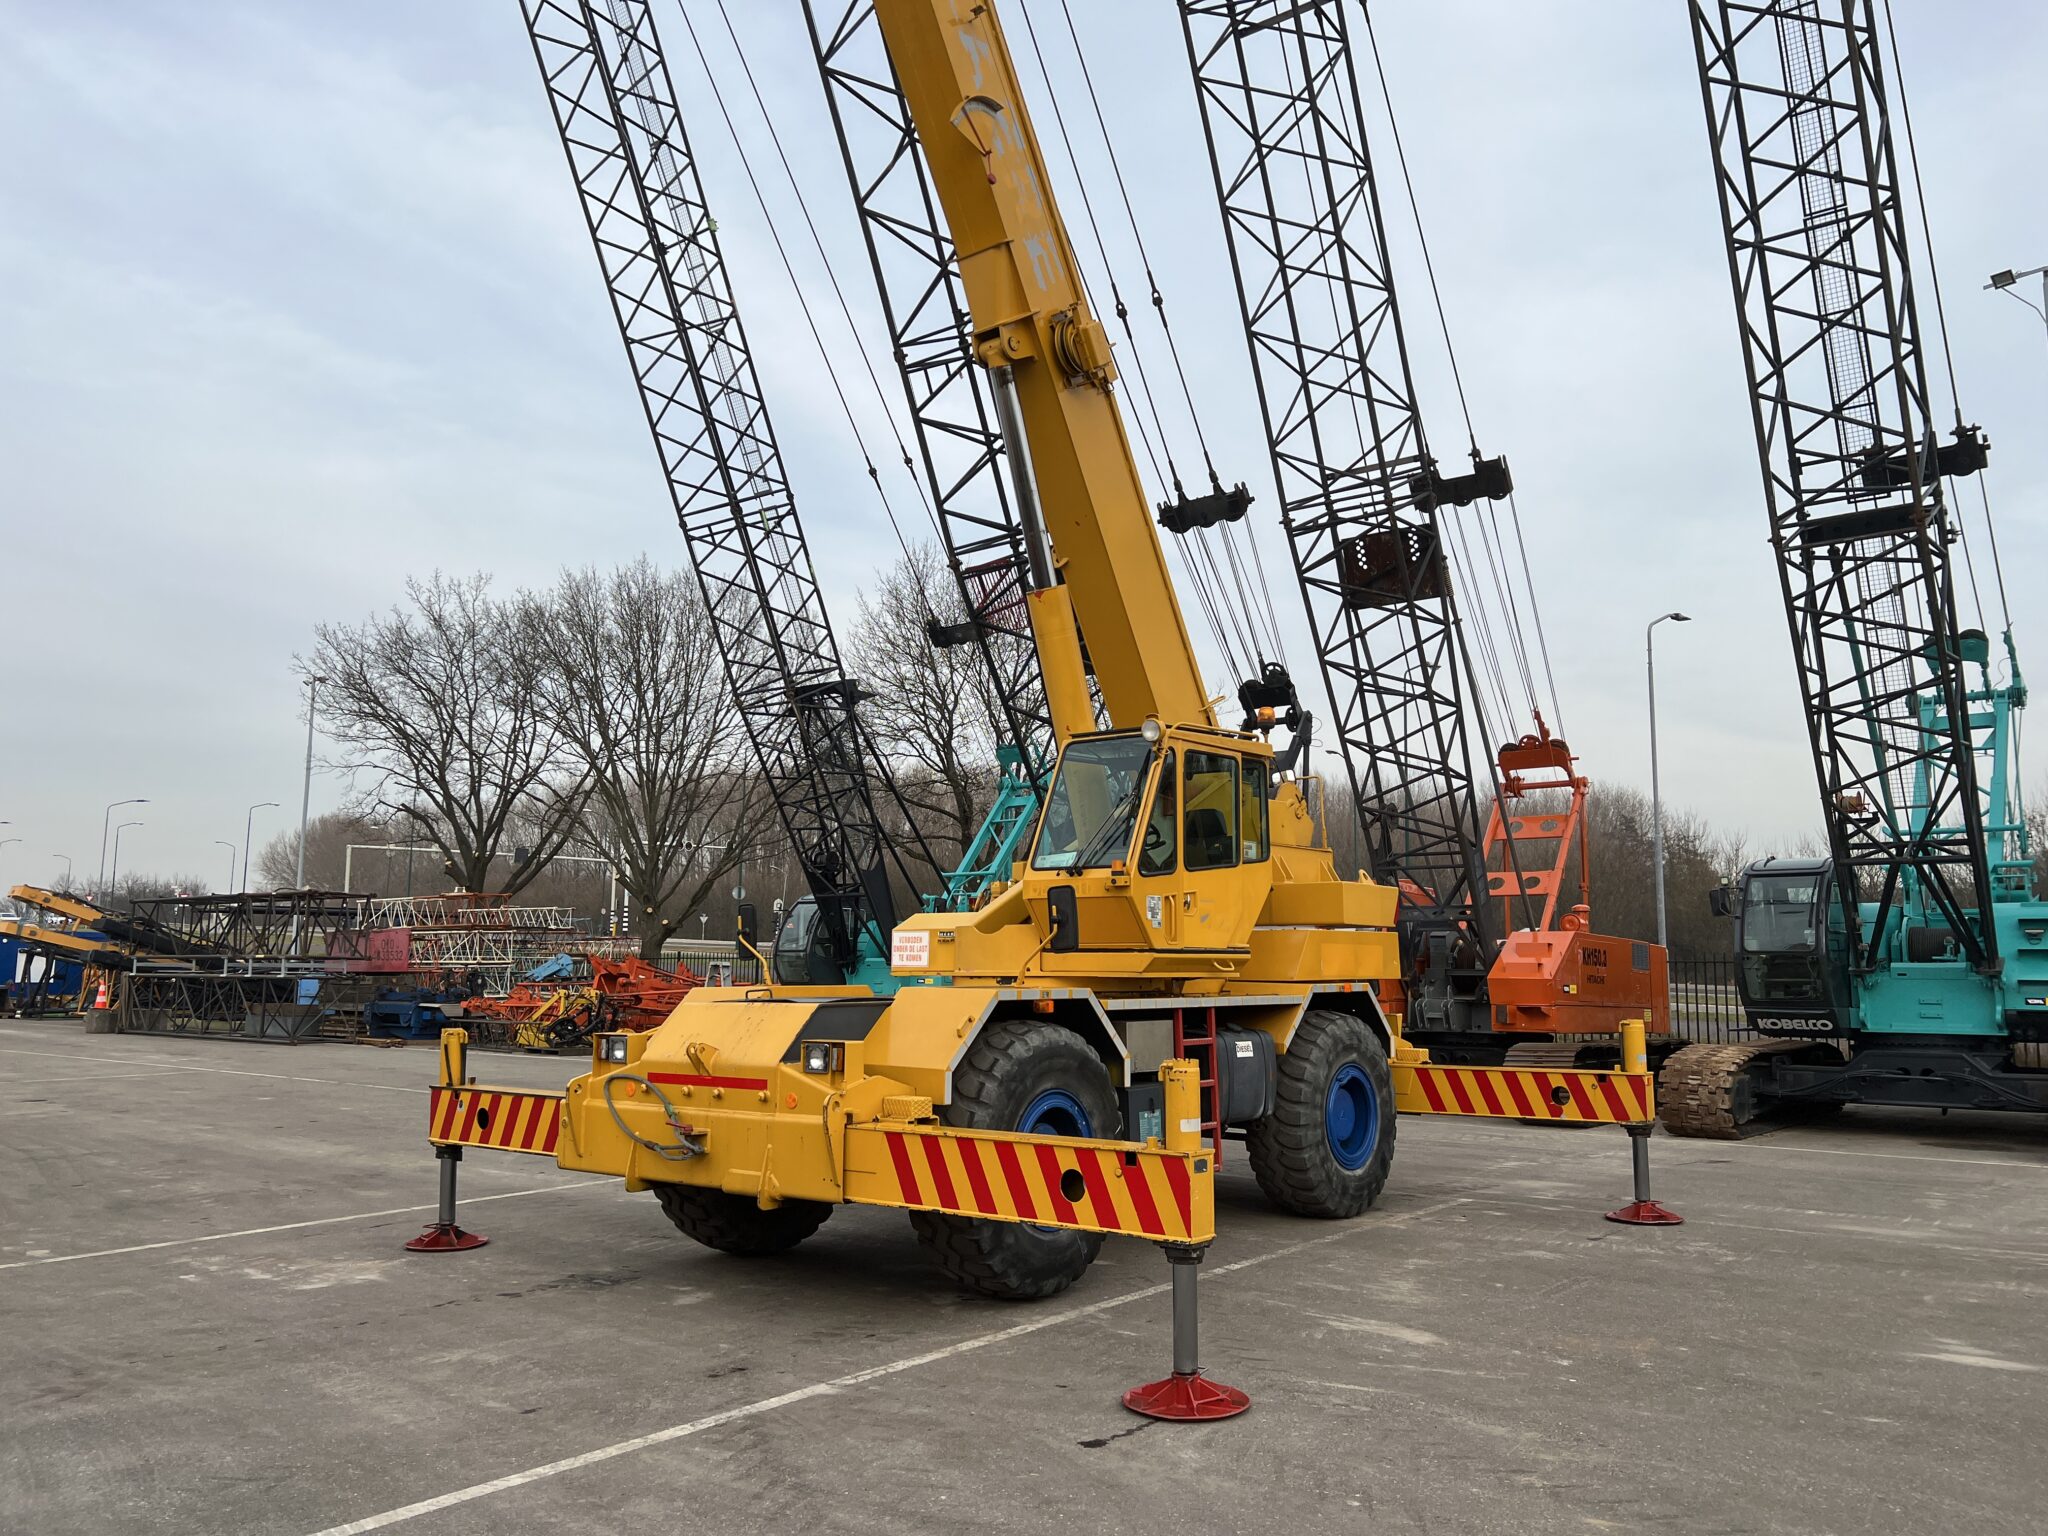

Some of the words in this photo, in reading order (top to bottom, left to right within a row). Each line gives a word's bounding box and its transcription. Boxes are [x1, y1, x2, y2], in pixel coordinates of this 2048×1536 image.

[899, 936, 922, 944] VERBODEN
[893, 945, 908, 953] ONDER
[909, 945, 915, 953] DE
[916, 945, 927, 953] LAST
[898, 954, 904, 962] TE
[906, 954, 922, 962] KOMEN
[1586, 974, 1605, 985] HITACHI
[1756, 1018, 1834, 1031] KOBELCO
